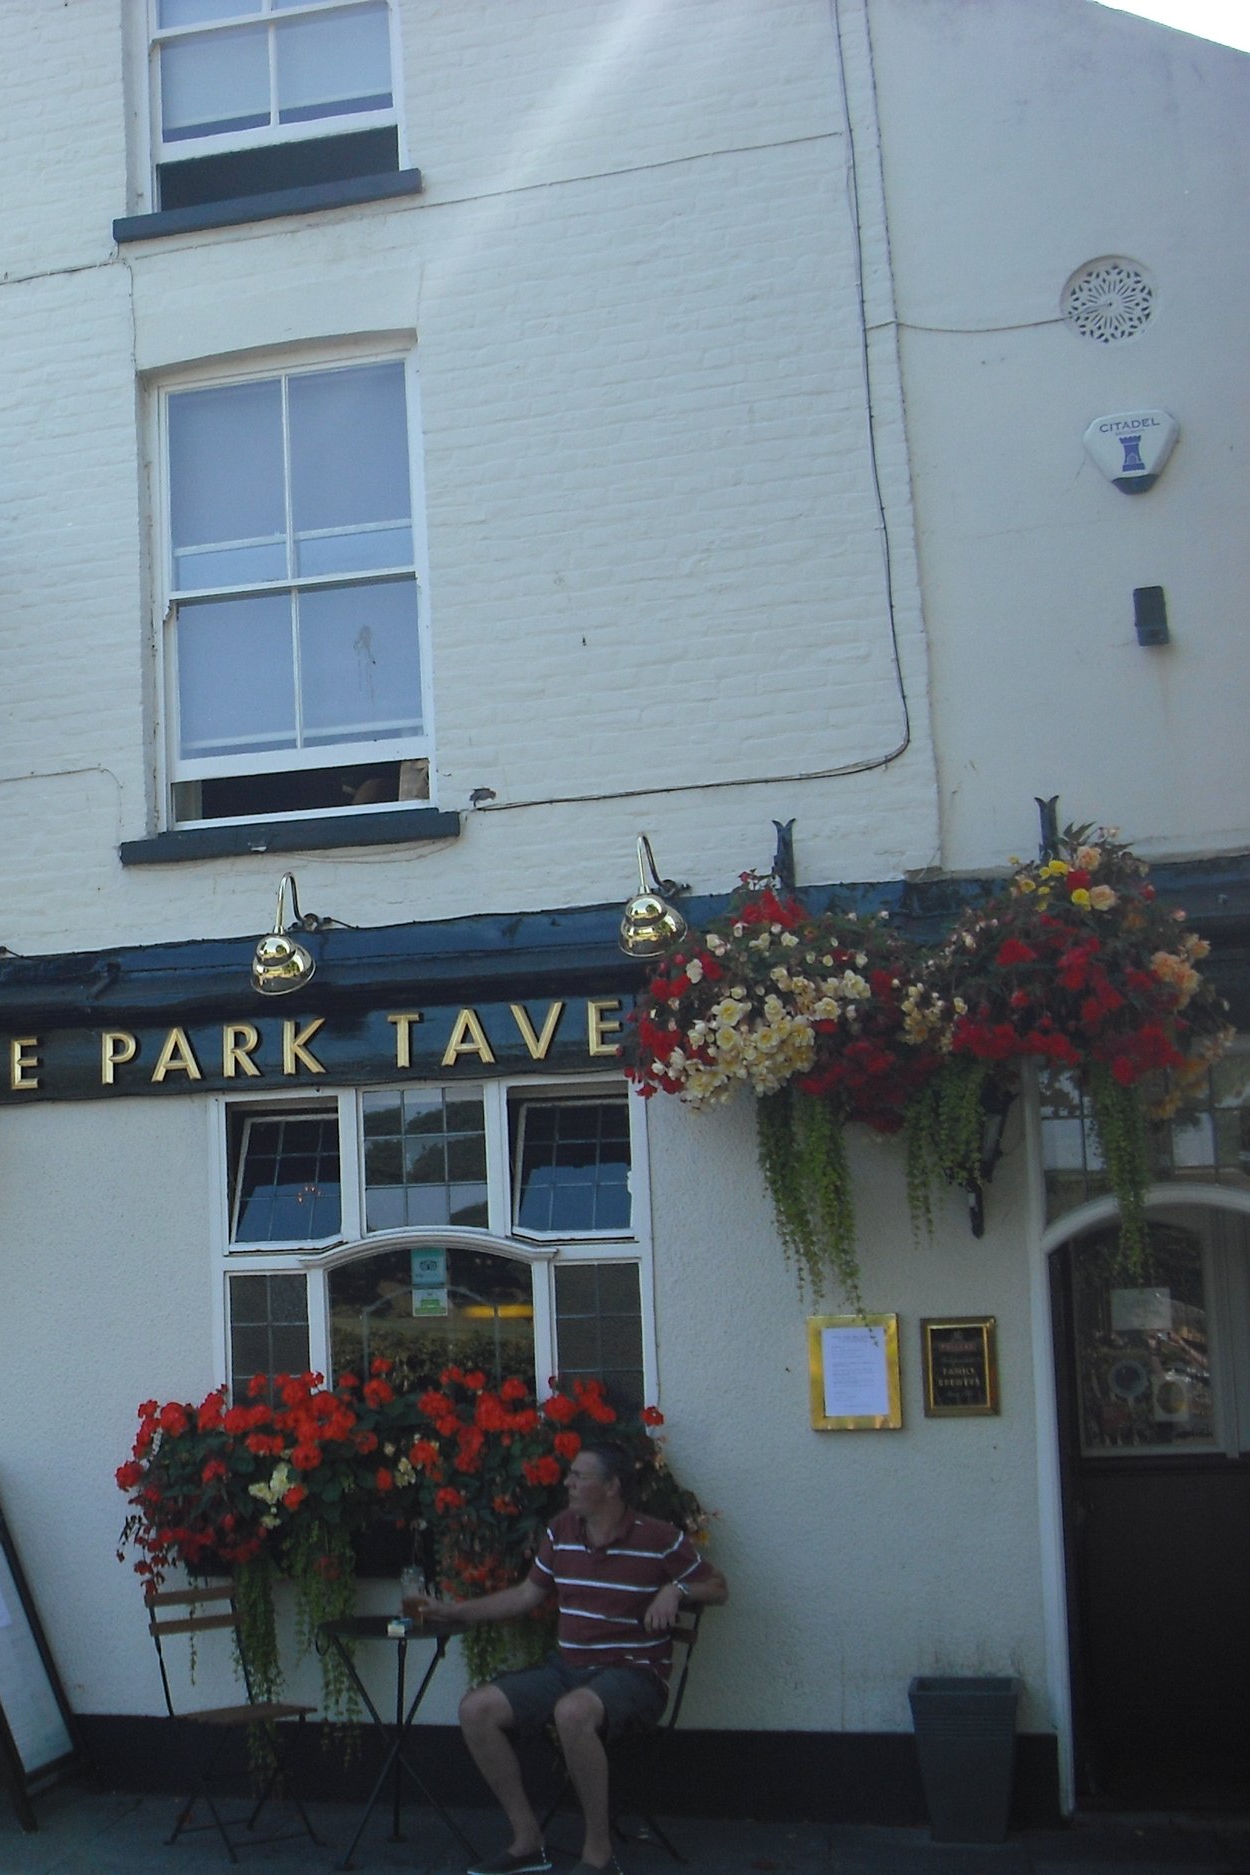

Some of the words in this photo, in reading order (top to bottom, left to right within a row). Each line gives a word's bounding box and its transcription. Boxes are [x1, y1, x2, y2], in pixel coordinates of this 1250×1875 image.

[1099, 417, 1161, 433] CITADEL
[101, 1017, 327, 1085] PARK
[387, 999, 623, 1069] TAVE
